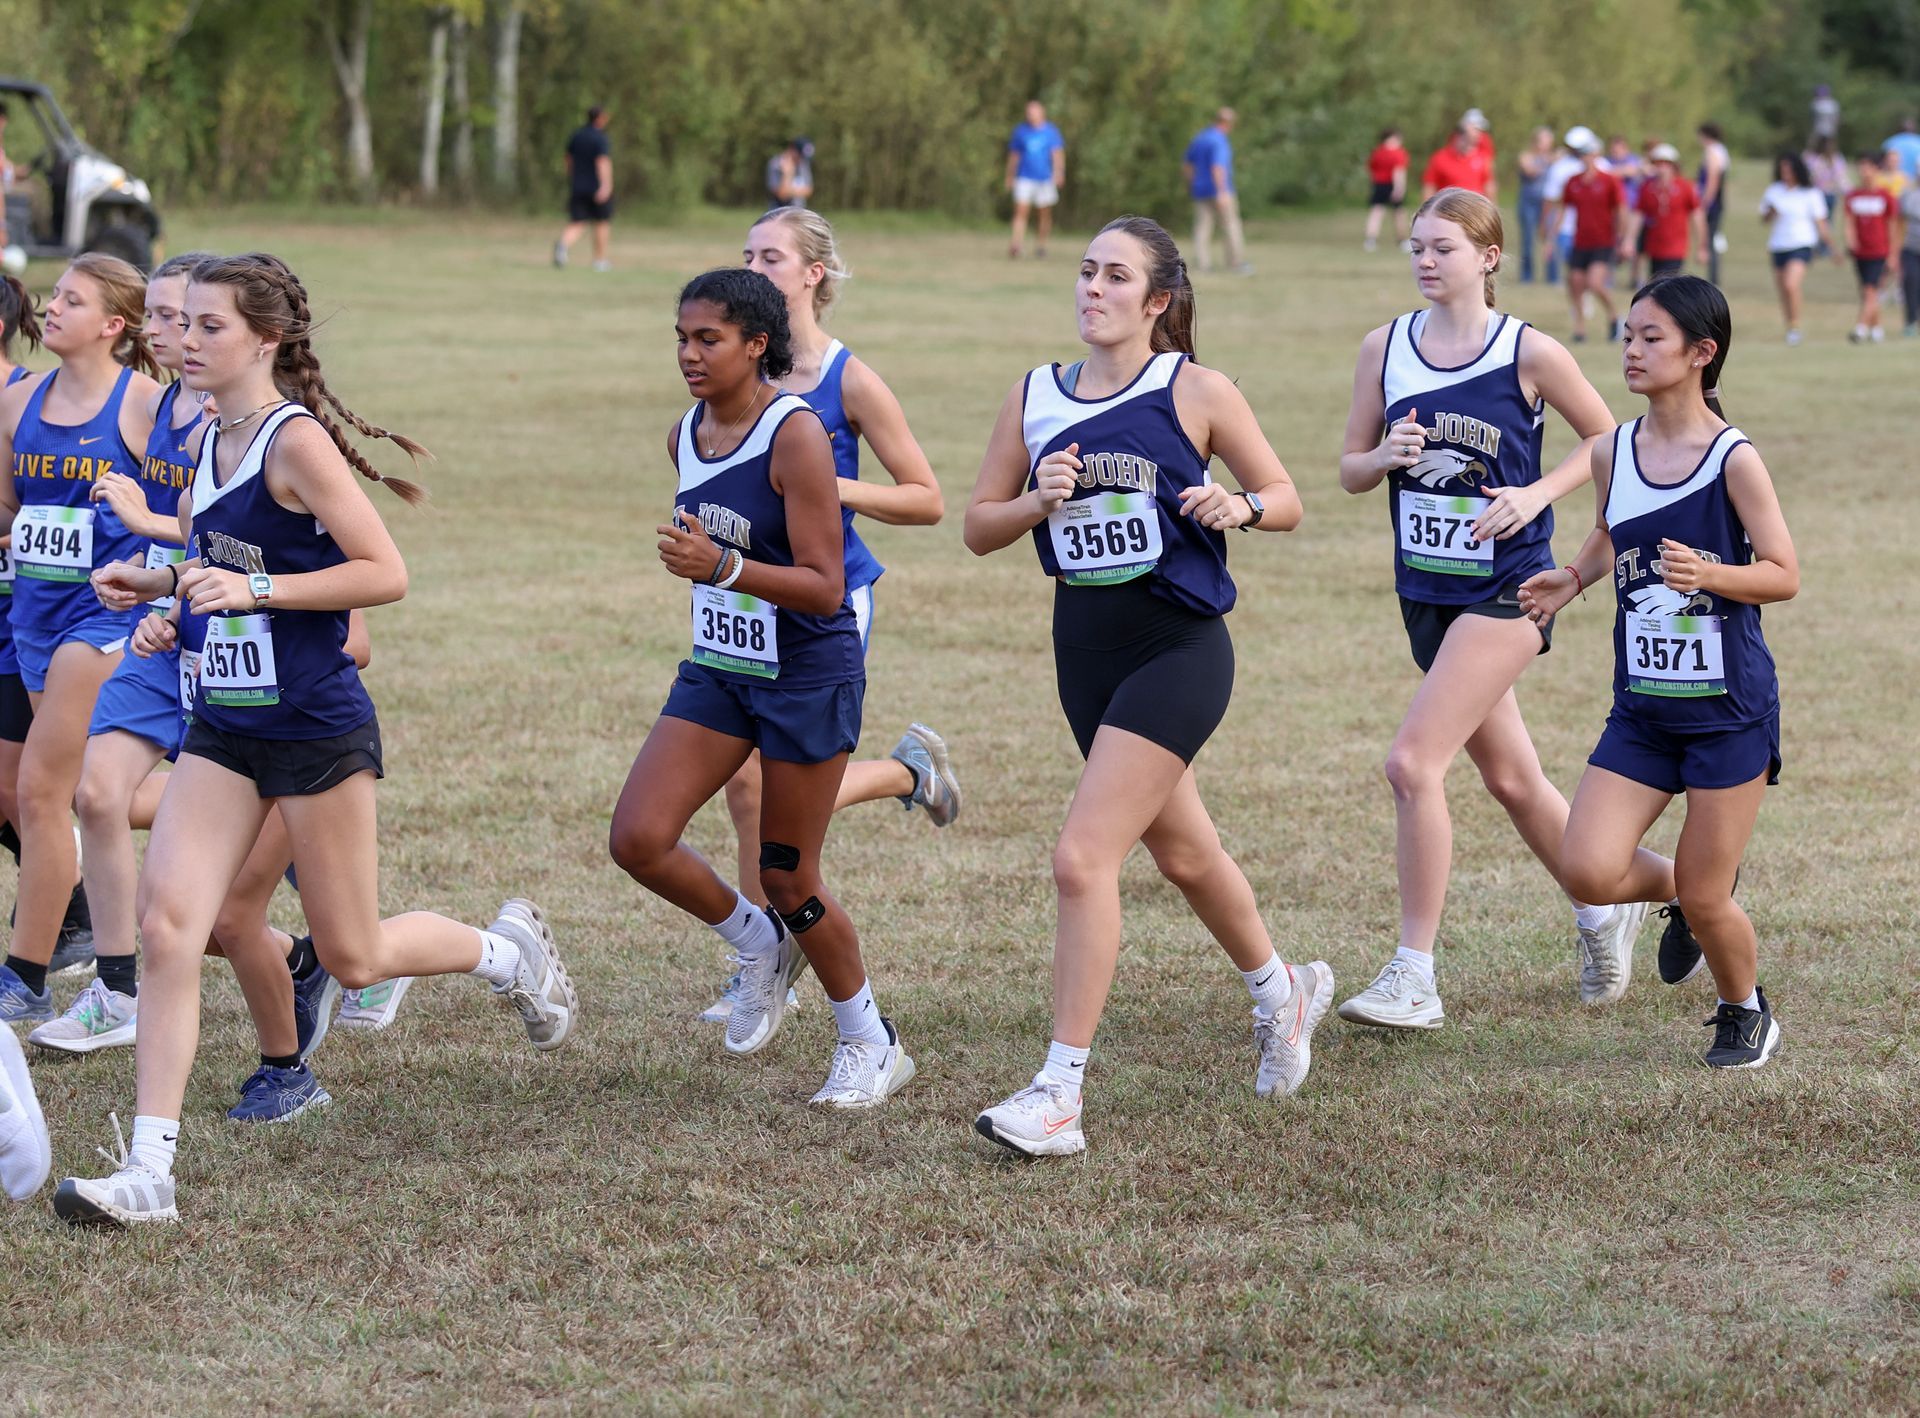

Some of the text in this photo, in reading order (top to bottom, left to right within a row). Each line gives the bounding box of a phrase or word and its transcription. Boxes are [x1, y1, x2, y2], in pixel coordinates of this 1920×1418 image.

[1426, 412, 1501, 459] JOHN
[141, 456, 168, 485] IVE
[1077, 452, 1158, 497] JOHN
[19, 523, 82, 558] 3494
[208, 531, 266, 574] JOHN
[1063, 517, 1149, 561] 3569
[1616, 547, 1646, 589] ST.
[701, 607, 765, 651] 3568
[206, 641, 262, 678] 3570
[1635, 635, 1708, 671] 3571
